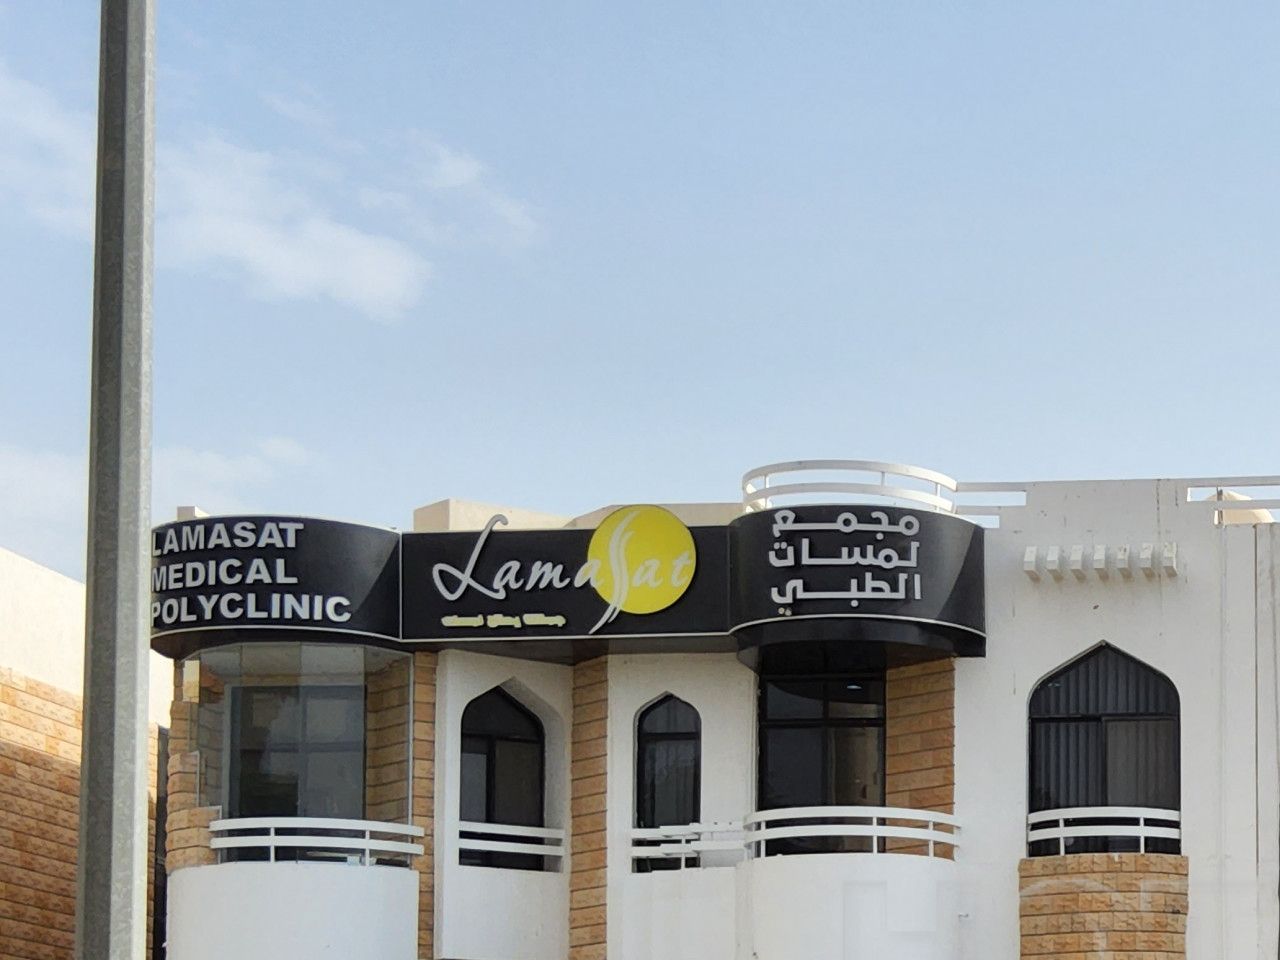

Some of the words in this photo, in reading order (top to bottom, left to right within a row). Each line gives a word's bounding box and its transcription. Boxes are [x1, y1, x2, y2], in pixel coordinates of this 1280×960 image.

[152, 521, 304, 557] LAMASAT
[771, 509, 920, 541] مجمع
[768, 538, 919, 569] لمسات
[151, 557, 298, 592] MEDICAL
[151, 592, 352, 627] POLYCLINIC
[771, 572, 922, 616] الطبي
